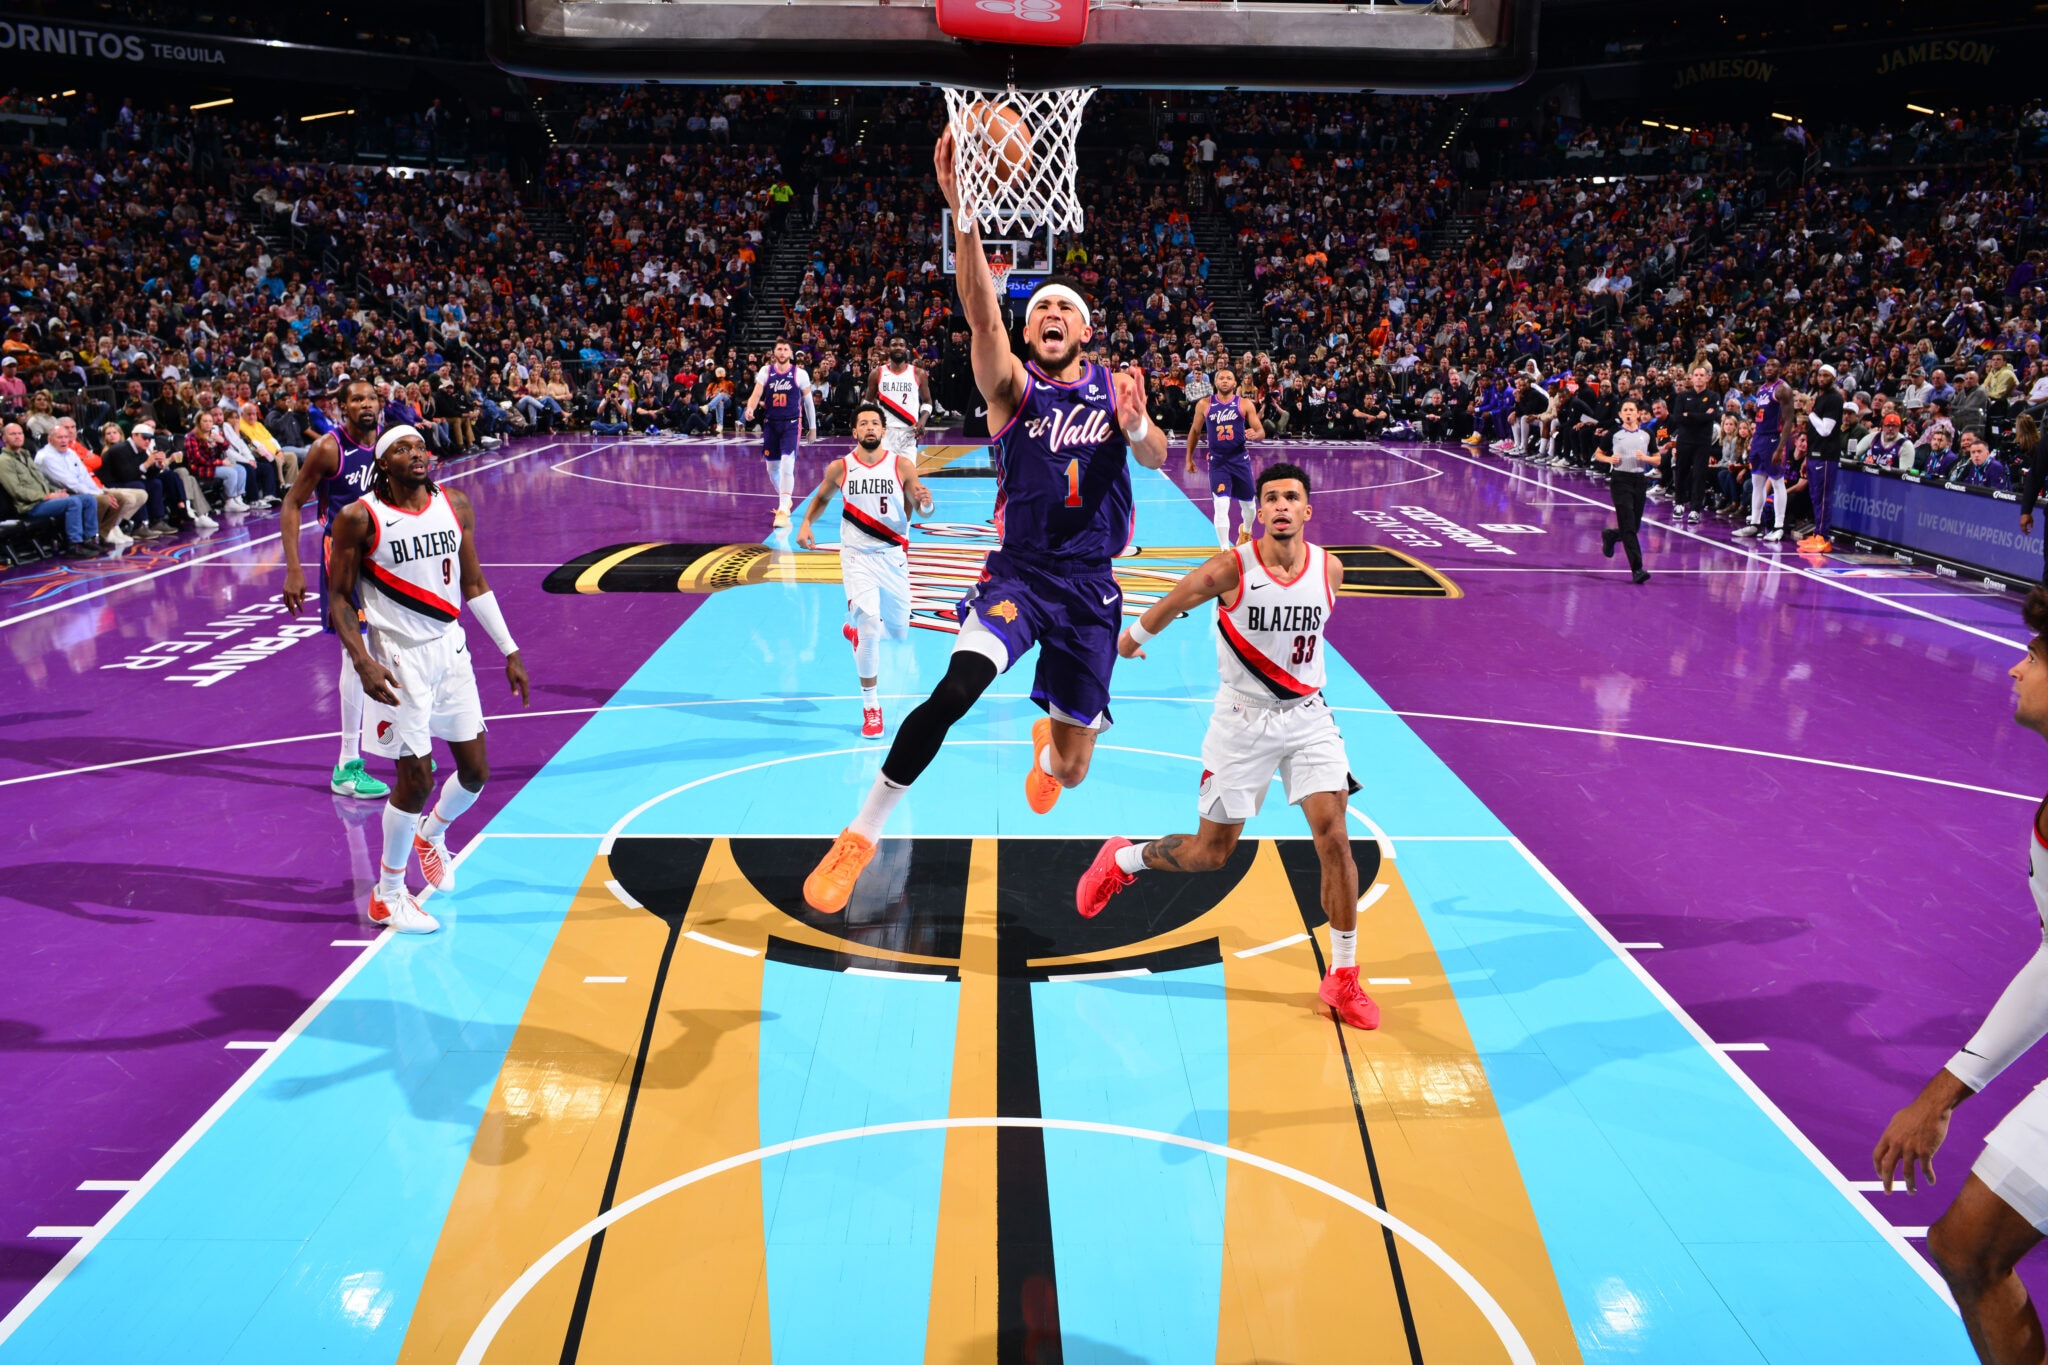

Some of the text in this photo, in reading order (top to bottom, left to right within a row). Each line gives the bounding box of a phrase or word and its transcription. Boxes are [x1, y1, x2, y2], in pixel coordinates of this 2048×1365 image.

[0, 20, 226, 64] ORNITOS TEQUILA
[1874, 40, 1996, 76] JAMESON
[1673, 59, 1775, 91] JAMESON
[772, 393, 787, 407] 20
[882, 381, 912, 393] BLAZERS
[902, 393, 908, 405] 2
[1085, 394, 1107, 402] PayPal
[1050, 403, 1113, 453] Valle
[1216, 424, 1235, 441] 23
[848, 478, 894, 496] BLAZERS
[1064, 458, 1082, 507] 1
[880, 496, 888, 515] 5
[1834, 485, 1903, 522] ketmaster
[1352, 510, 1443, 547] CENTER
[1390, 505, 1517, 555] FOOTPRINT
[1917, 511, 1939, 530] LIVE
[1940, 517, 1966, 535] ONLY
[1965, 522, 2014, 548] HAPPENS
[390, 529, 457, 564] BLAZERS
[441, 557, 452, 585] 9
[1248, 605, 1322, 632] BLAZERS
[1291, 634, 1317, 665] 33
